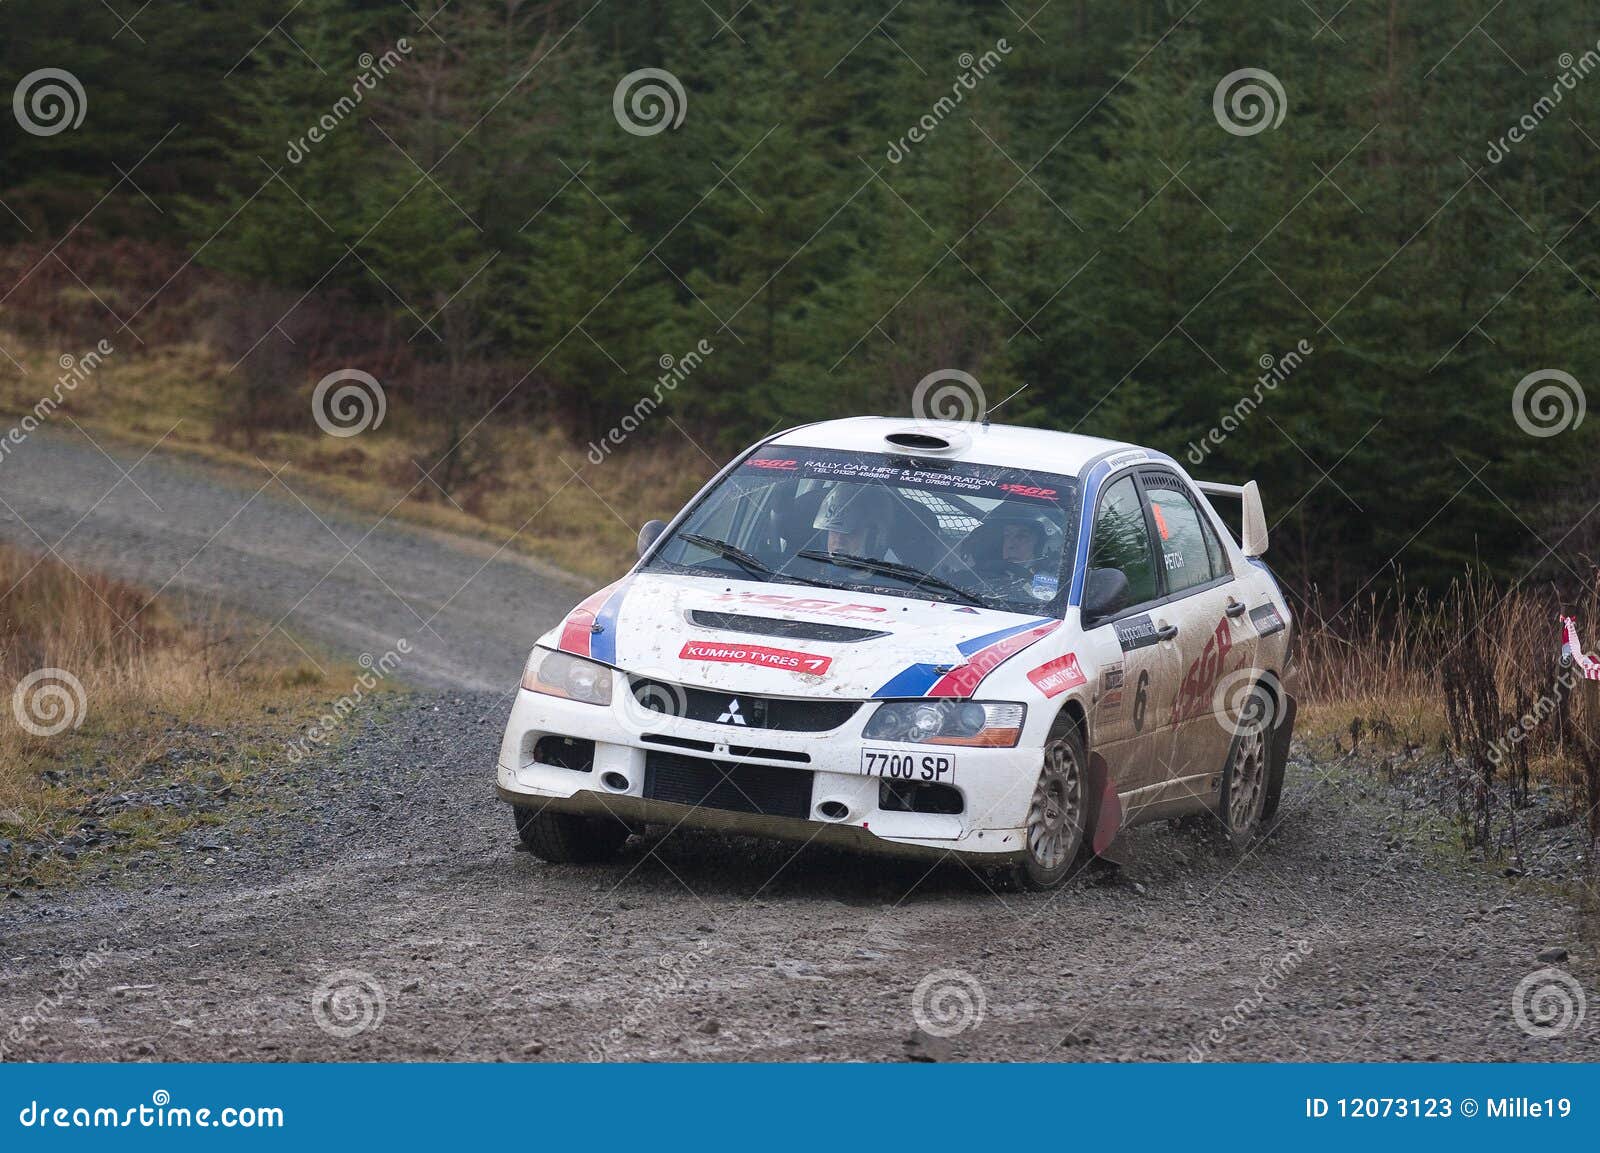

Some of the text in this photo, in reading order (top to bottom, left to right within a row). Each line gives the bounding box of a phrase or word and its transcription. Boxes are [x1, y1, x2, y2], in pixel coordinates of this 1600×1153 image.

[804, 460, 842, 469] RALLY
[843, 463, 869, 472] CAR
[871, 466, 900, 475] HIRE
[913, 470, 998, 488] PREPARATION
[1164, 552, 1185, 570] PETCH
[687, 646, 800, 668] KUMHO TYRES
[1133, 668, 1149, 733] 6
[865, 753, 950, 781] 7700 SP
